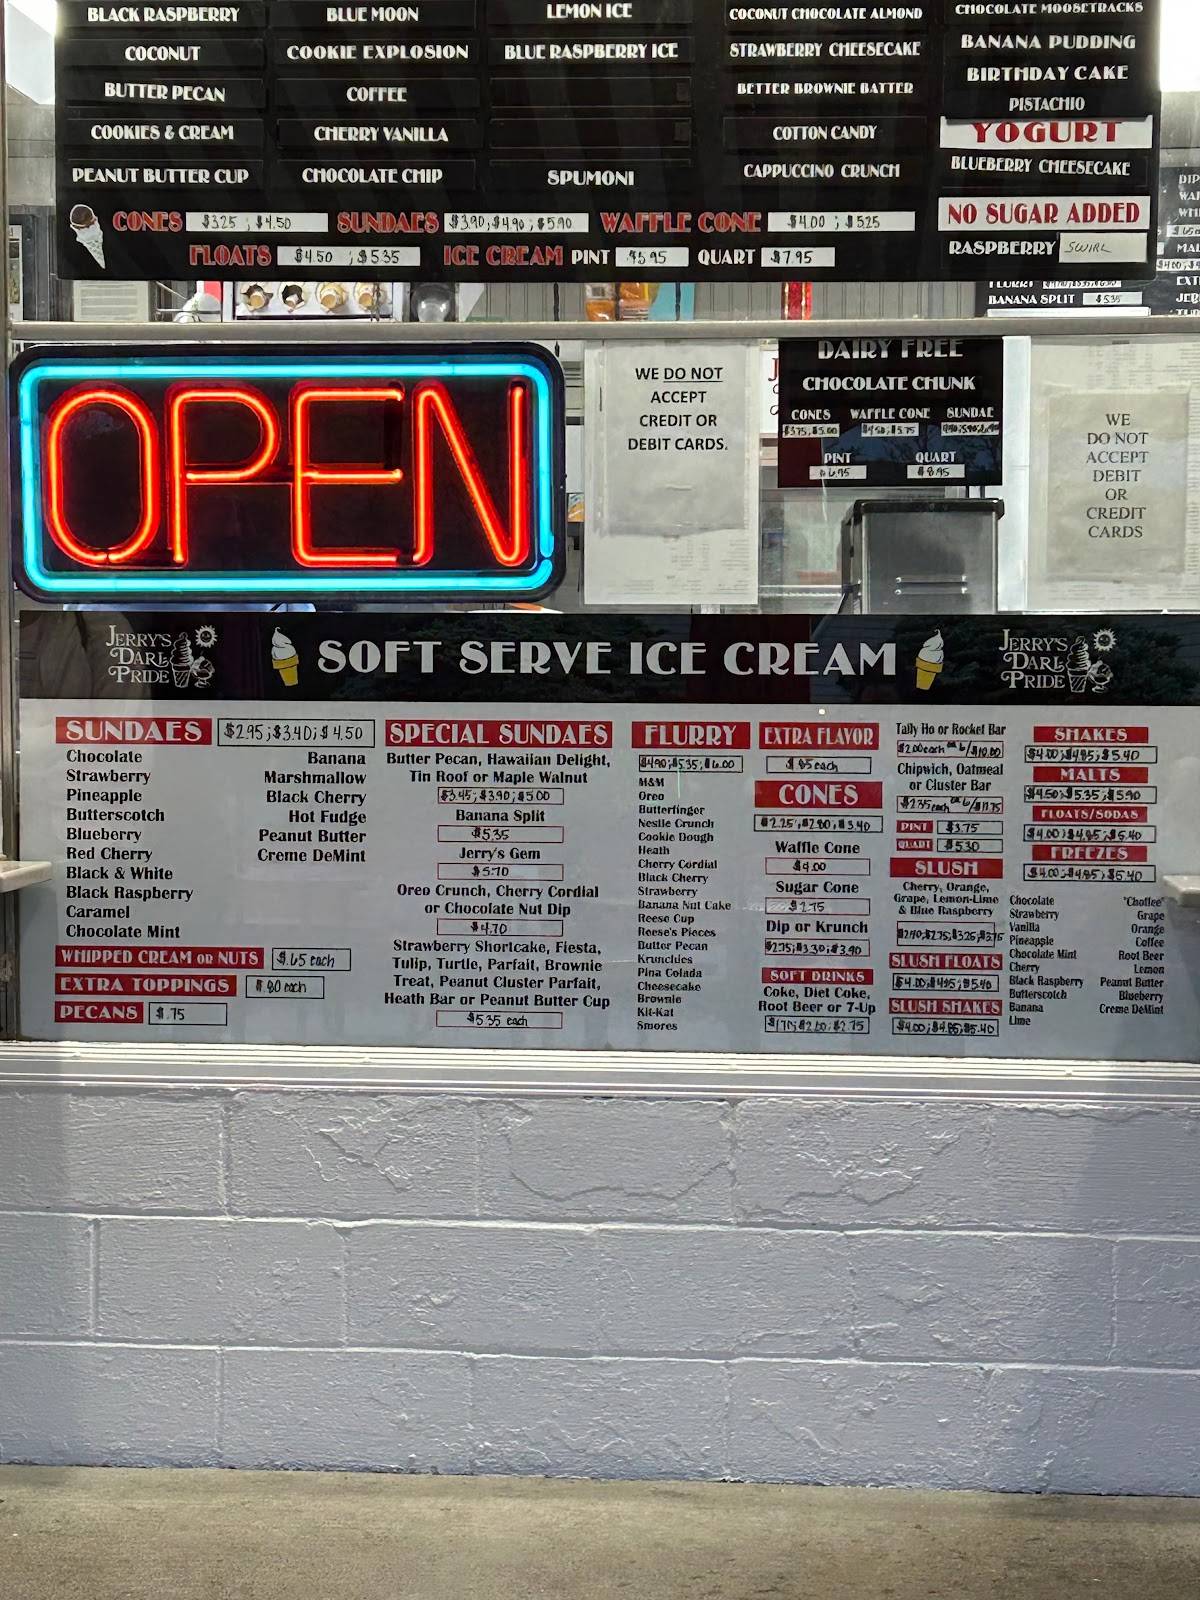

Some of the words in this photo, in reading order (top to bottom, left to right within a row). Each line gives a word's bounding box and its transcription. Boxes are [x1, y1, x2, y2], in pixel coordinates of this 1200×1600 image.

[88, 7, 140, 22] BLACK
[144, 7, 239, 21] RASPBERRY
[327, 7, 367, 22] BLUE
[372, 7, 418, 21] MOON
[547, 3, 601, 18] LEMON
[606, 3, 632, 18] ICE
[730, 8, 788, 20] COCONUT
[792, 8, 866, 19] CHOCOLATE
[870, 8, 922, 19] ALMOND
[955, 4, 1037, 14] CHOCOLATE
[1041, 2, 1143, 13] MOOSETRACKS
[961, 34, 1041, 48] BANANA
[1049, 35, 1135, 49] PUDDING
[125, 46, 200, 61] COCONUT
[287, 46, 356, 59] COOKIE
[363, 45, 468, 59] EXPLOSION
[505, 45, 545, 59] BLUE
[550, 44, 647, 59] RASPBERRY
[652, 43, 678, 58] ICE
[730, 43, 822, 57] STRAWBERRY
[829, 42, 920, 56] CHEESECAKE
[967, 67, 1069, 81] BIRTHDAY
[1074, 65, 1128, 80] CAKE
[105, 83, 168, 99] BUTTER
[172, 86, 225, 102] PECAN
[347, 87, 407, 102] COFFEE
[738, 83, 790, 94] BETTER
[794, 83, 855, 94] BROWNIE
[860, 82, 913, 94] BATTER
[1009, 97, 1085, 111] PISTACHIO
[91, 125, 160, 140] COOKIES
[179, 125, 233, 139] CREAM
[314, 127, 379, 141] CHERRY
[383, 127, 448, 141] VANILLA
[773, 126, 827, 140] COTTON
[831, 125, 877, 139] CANDY
[972, 122, 1122, 143] YOGURT
[744, 164, 834, 178] CAPPUCCINO
[841, 164, 900, 177] CRUNCH
[951, 156, 1032, 172] BLUEBERRY
[1039, 159, 1130, 175] CHEESECAKE
[73, 168, 139, 182] PEANUT
[144, 169, 210, 183] BUTTER
[214, 169, 249, 183] CUP
[302, 168, 397, 183] CHOCOLATE
[402, 169, 442, 183] CHIP
[548, 170, 634, 185] SPUMONI
[949, 204, 977, 224] NO
[986, 203, 1058, 224] SUGAR
[1067, 203, 1139, 223] ADDED
[112, 211, 184, 232] CONES
[337, 212, 439, 233] SUNDAES
[600, 212, 692, 233] WAFFLE
[698, 212, 761, 233] CONE
[949, 241, 1056, 256] RASPBERRY
[1064, 241, 1110, 253] SWIRL
[190, 245, 272, 266] FLOATS
[444, 245, 479, 265] ICE
[486, 245, 563, 265] CREAM
[572, 250, 610, 264] PINT
[698, 249, 755, 265] QUART
[989, 295, 1037, 304] BANANA
[1040, 294, 1075, 304] SPLIT
[818, 340, 890, 359] DAIRY
[901, 339, 963, 358] FREE
[635, 367, 659, 380] WE
[664, 367, 687, 380] DO
[691, 367, 723, 380] NOT
[803, 377, 908, 390] CHOCOLATE
[912, 376, 975, 390] CHUNK
[651, 391, 706, 403] ACCEPT
[791, 409, 831, 420] CONES
[850, 408, 895, 419] WAFFLE
[899, 408, 930, 419] CONE
[946, 407, 994, 418] SUNDAE
[640, 415, 692, 427] CREDIT
[696, 415, 716, 426] OR
[1106, 414, 1130, 426] WE
[629, 438, 671, 450] DEBIT
[675, 438, 727, 450] CARDS.
[1088, 433, 1110, 444] DO
[1115, 432, 1148, 444] NOT
[824, 452, 852, 464] PINT
[915, 451, 957, 463] QUART
[1086, 451, 1149, 463] ACCEPT
[45, 380, 533, 568] OPEN
[1093, 470, 1141, 482] DEBIT
[1105, 489, 1128, 500] OR
[1087, 507, 1146, 519] CREDIT
[1089, 526, 1142, 538] CARDS
[318, 640, 442, 673] SOFT
[460, 641, 611, 674] SERVE
[630, 642, 706, 675] ICE
[724, 642, 896, 675] CREAM
[66, 720, 202, 741] SUNDAES
[390, 723, 489, 743] SPECIAL
[499, 725, 608, 745] SUNDAES
[645, 725, 736, 745] FLURRY
[765, 727, 812, 744] EXTRA
[817, 728, 873, 745] FLAVOR
[1055, 728, 1128, 741] SHAKES
[67, 750, 142, 762] Chocolate
[308, 752, 366, 764] Banana
[387, 753, 431, 764] Butter
[436, 753, 482, 766] Pecan,
[488, 753, 551, 765] Hawaiian
[556, 754, 610, 768] Delight,
[67, 769, 150, 785] Strawberry
[897, 763, 952, 777] Chipwich,
[956, 763, 1004, 776] Oatmeal
[1060, 768, 1121, 781] MALTS
[265, 771, 366, 784] Marshmallow
[66, 789, 142, 805] Pineapple
[267, 790, 308, 803] Black
[315, 791, 366, 806] Cherry
[779, 784, 858, 805] CONES
[67, 808, 164, 821] Butterscotch
[456, 810, 508, 821] Banana
[514, 810, 545, 824] Split
[639, 805, 705, 815] Butterfinger
[66, 828, 142, 844] Blueberry
[259, 829, 312, 841] Peanut
[319, 830, 366, 842] Butter
[639, 832, 675, 842] Cookie
[679, 833, 713, 843] Dough
[776, 841, 819, 854] Waffle
[825, 842, 861, 853] Cone
[67, 847, 94, 859] Red
[101, 847, 152, 863] Cherry
[67, 867, 108, 879] Black
[131, 867, 172, 879] White
[915, 861, 978, 875] SLUSH
[66, 886, 109, 899] Black
[115, 886, 193, 902] Raspberry
[776, 881, 818, 894] Sugar
[824, 881, 859, 893] Cone
[66, 905, 129, 918] Caramel
[66, 925, 141, 938] Chocolate
[148, 926, 180, 938] Mint
[60, 978, 123, 992] EXTRA
[132, 978, 229, 992] TOPPINGS
[638, 982, 701, 991] Cheesecake
[61, 1005, 138, 1019] PECANS
